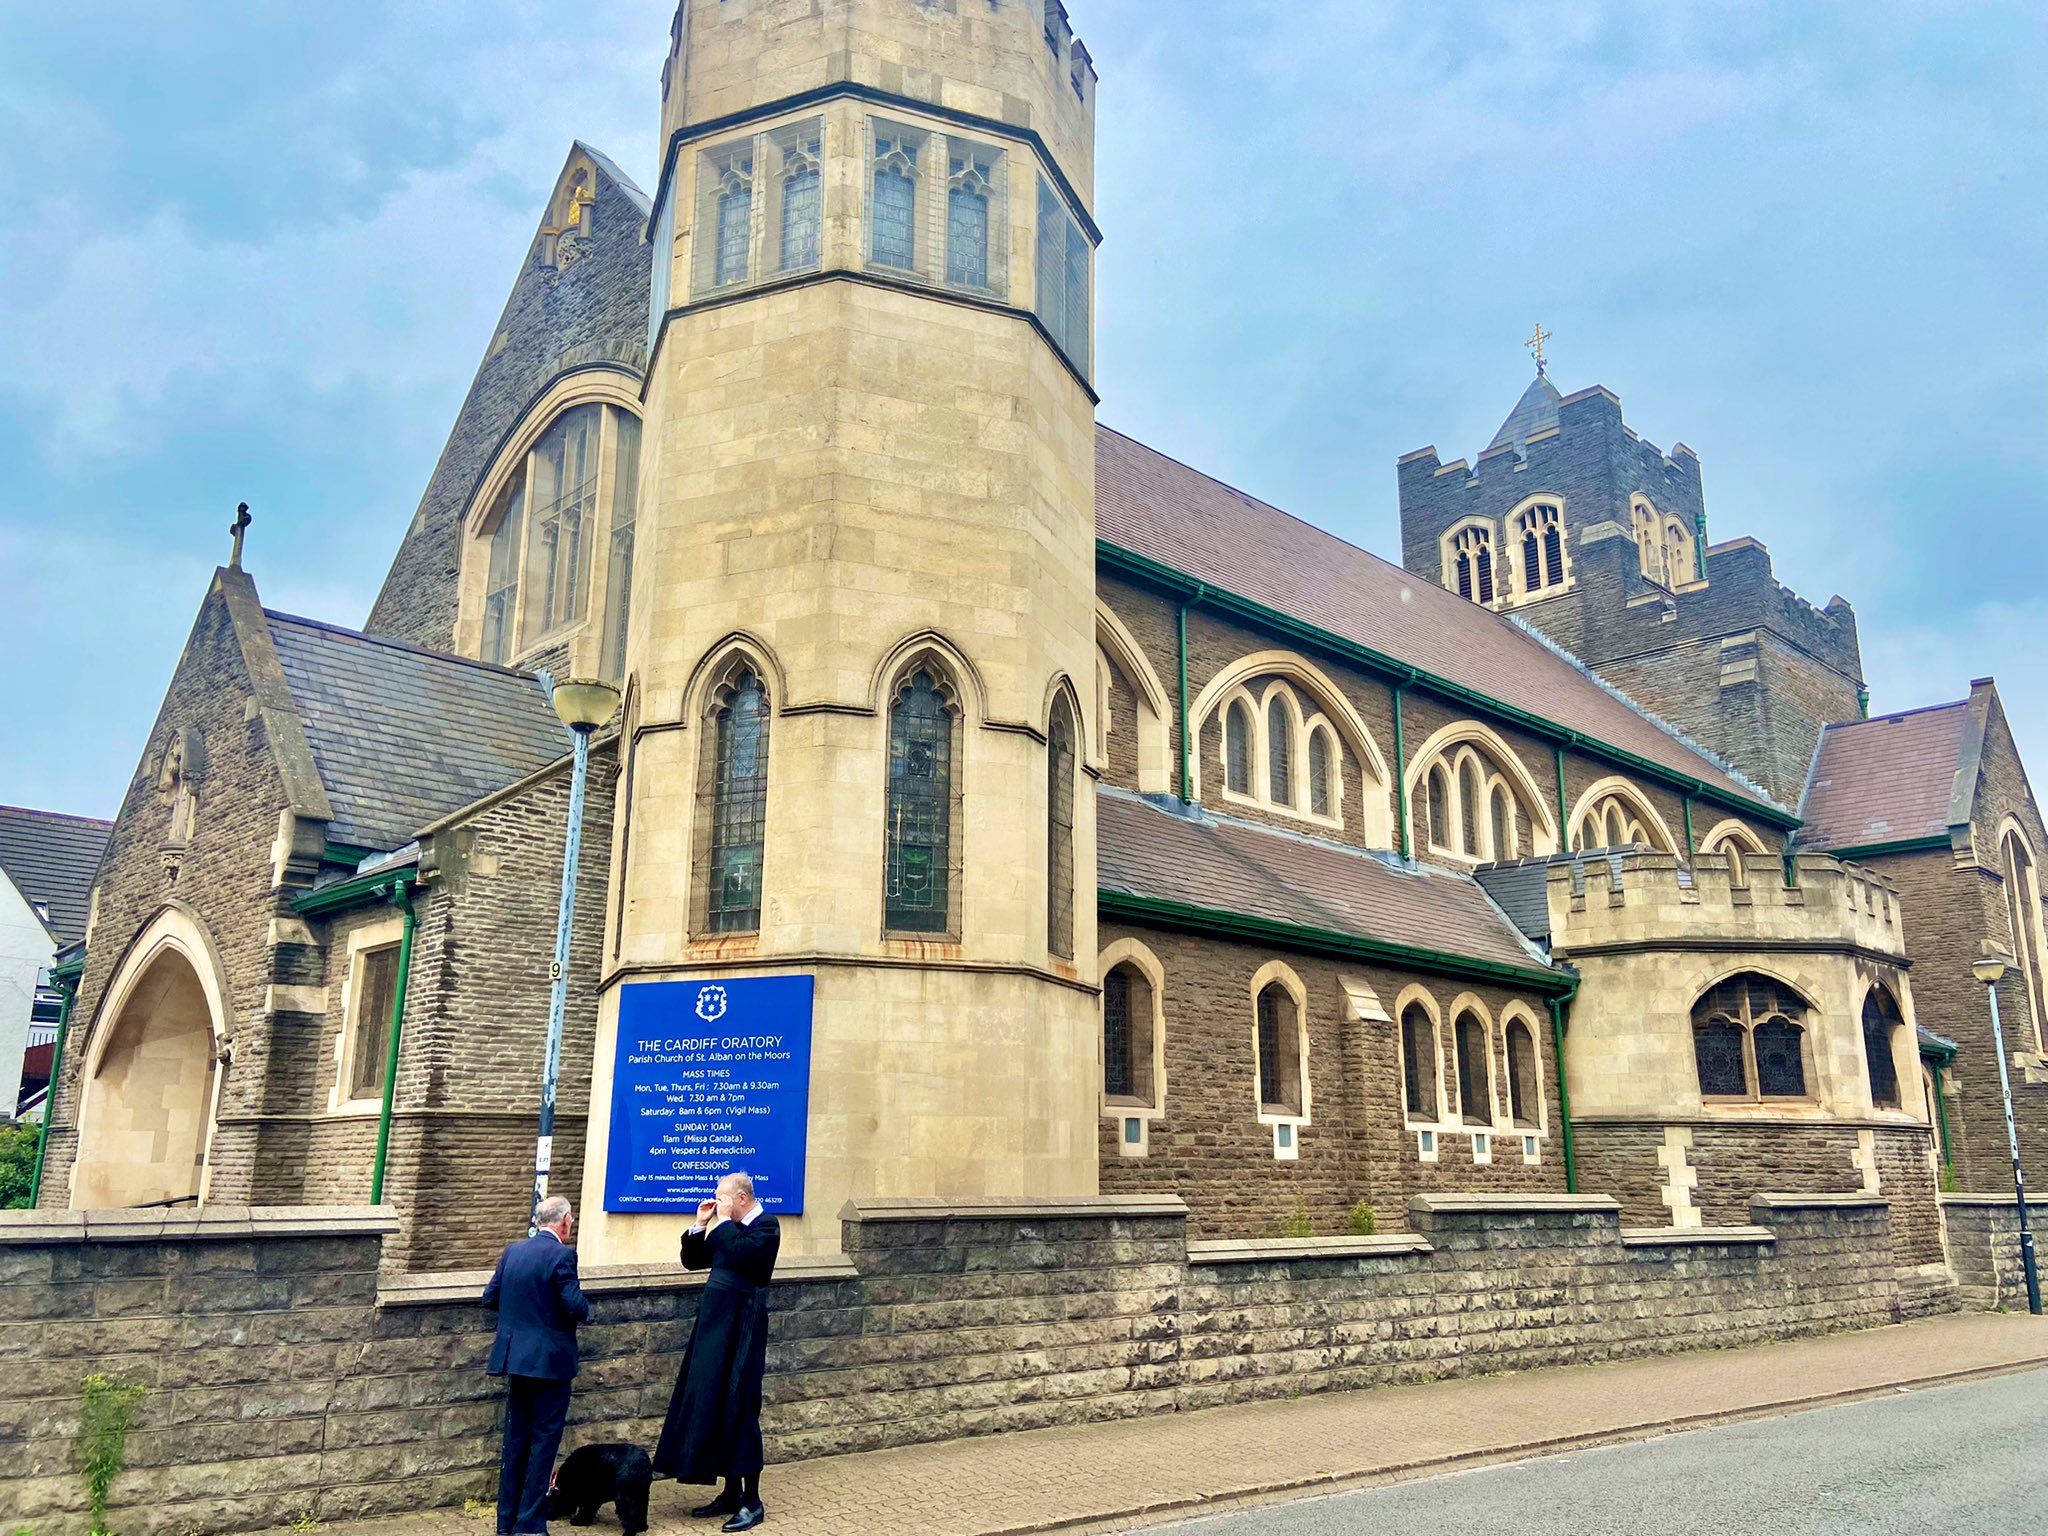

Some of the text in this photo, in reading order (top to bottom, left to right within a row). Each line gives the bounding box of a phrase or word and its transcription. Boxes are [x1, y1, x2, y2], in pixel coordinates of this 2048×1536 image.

[552, 963, 560, 977] 9
[638, 1035, 783, 1052] THE CARDIFF ORATORY
[628, 1051, 791, 1064] Parish Church of St. Alban on the Moors
[682, 1069, 731, 1079] MASS TIMES
[635, 1084, 652, 1093] Mon,
[671, 1083, 693, 1092] Thurs,
[713, 1082, 741, 1091] 7.30am
[742, 1082, 749, 1090] &
[750, 1081, 780, 1090] 9.30am
[689, 1094, 705, 1102] 7.30
[728, 1093, 745, 1102] 7pm
[640, 1105, 771, 1117] Saturday: 8am & 6pm (Vigil Mass)
[674, 1122, 732, 1132] SUNDAY: 10AM
[663, 1134, 743, 1144] 11am (Missa Cantata)
[649, 1146, 756, 1156] 4pm Vespers & Benediction
[672, 1160, 730, 1170] CONFESSIONS
[633, 1174, 647, 1182] Daily
[667, 1186, 716, 1195] www.cardifforatory
